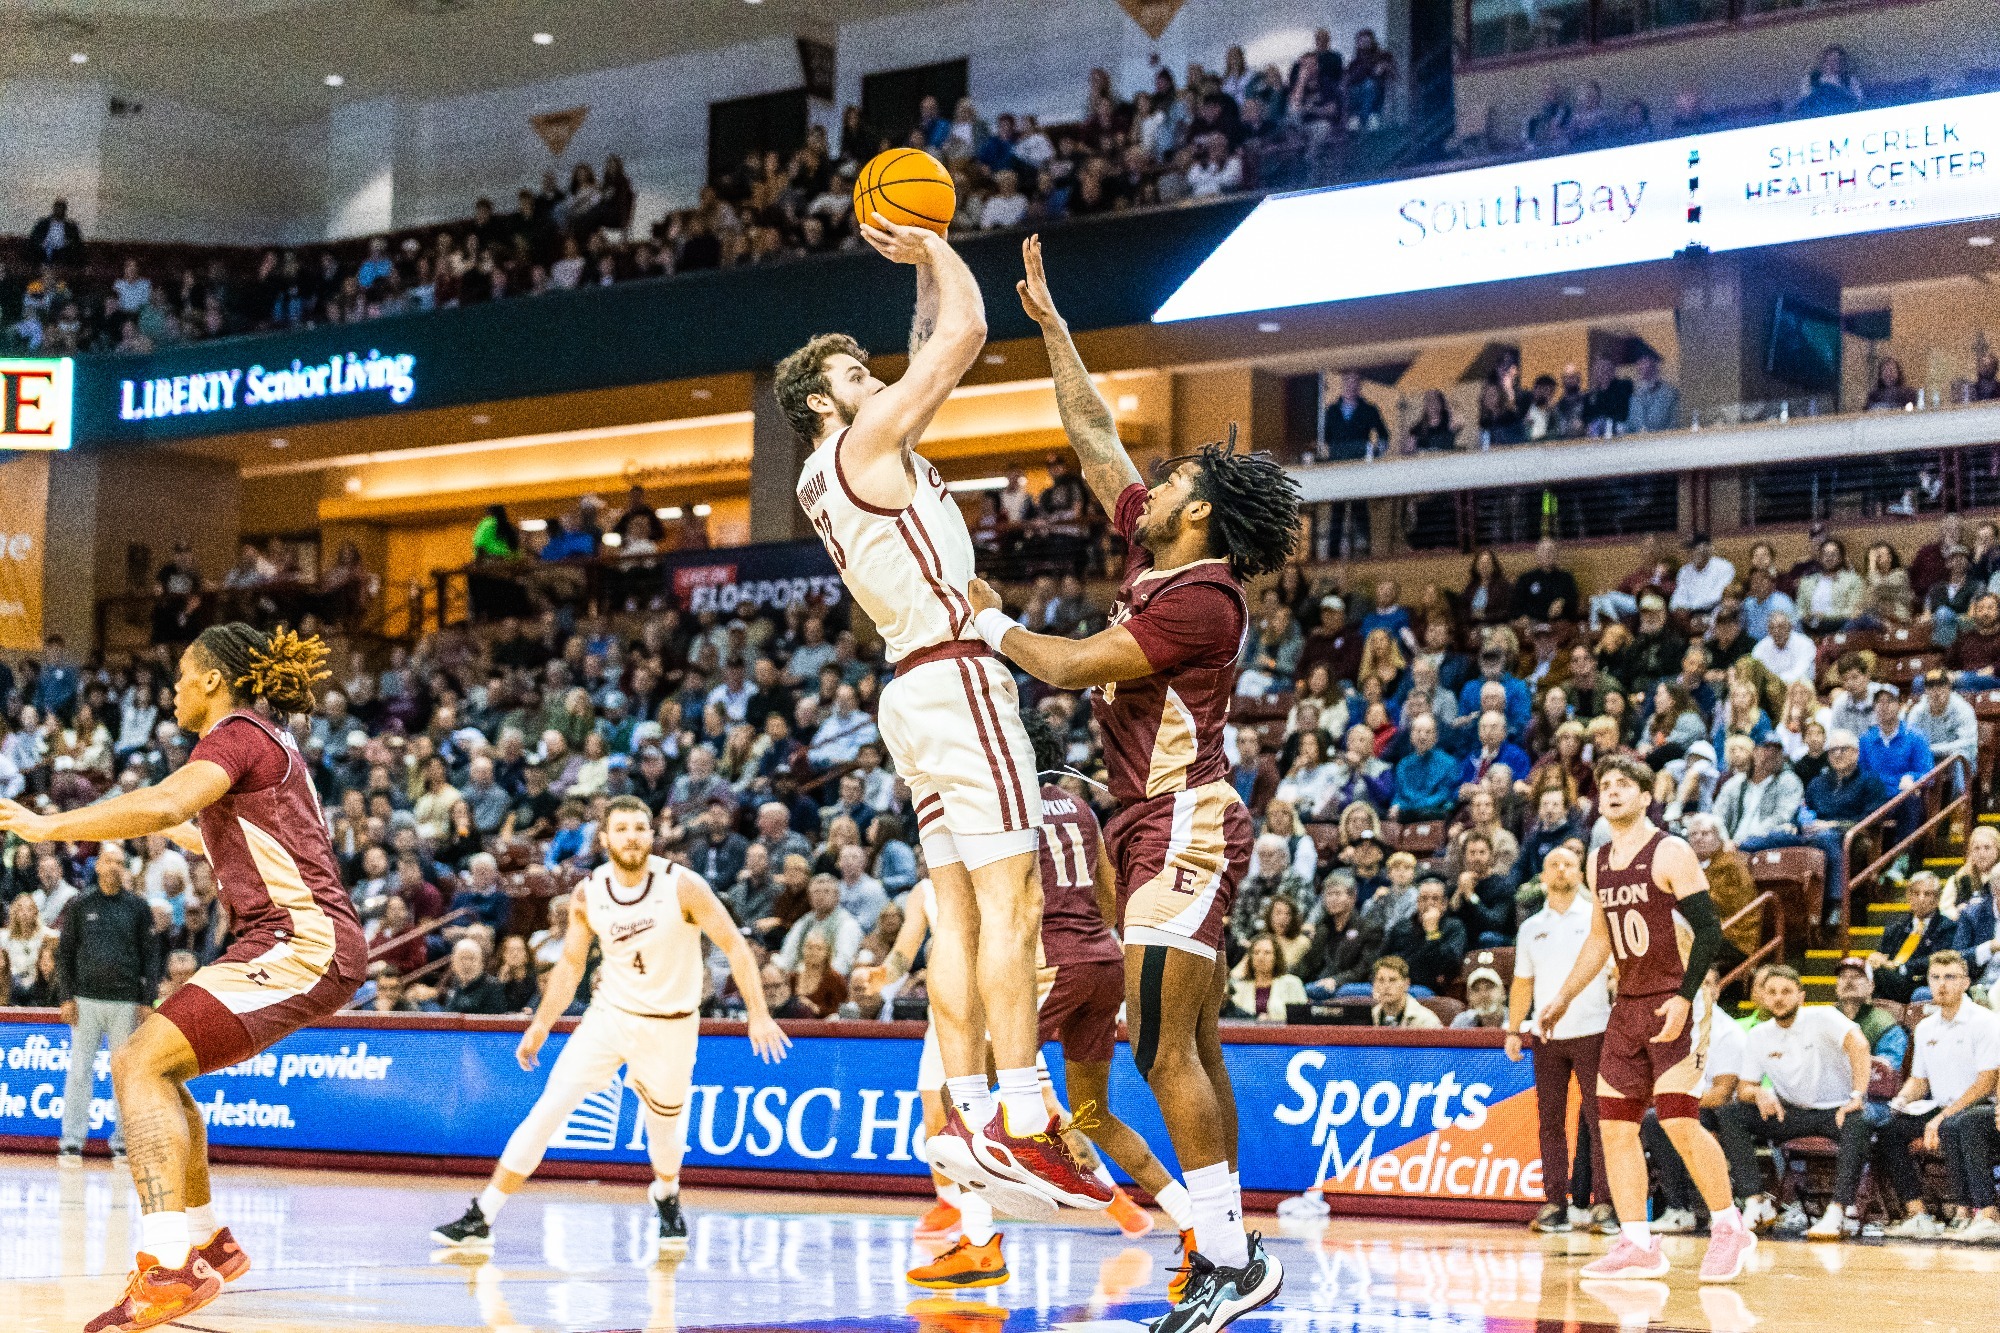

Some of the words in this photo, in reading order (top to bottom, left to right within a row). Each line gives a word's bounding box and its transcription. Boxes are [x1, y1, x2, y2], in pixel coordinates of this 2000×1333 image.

[1769, 138, 1849, 169] SHEM
[1862, 122, 1960, 155] CREEK
[1867, 151, 1986, 189] CENTER
[120, 368, 242, 420] LIBERTY
[1040, 822, 1094, 887] 11
[1171, 866, 1197, 895] E
[1598, 882, 1649, 909] ELON
[1607, 908, 1650, 960] 10
[633, 951, 646, 975] 4
[7, 1034, 72, 1071] offici
[279, 1041, 393, 1087] provider
[0, 1082, 27, 1119] he
[1273, 1050, 1493, 1147] Sports
[1314, 1128, 1545, 1198] Medicine
